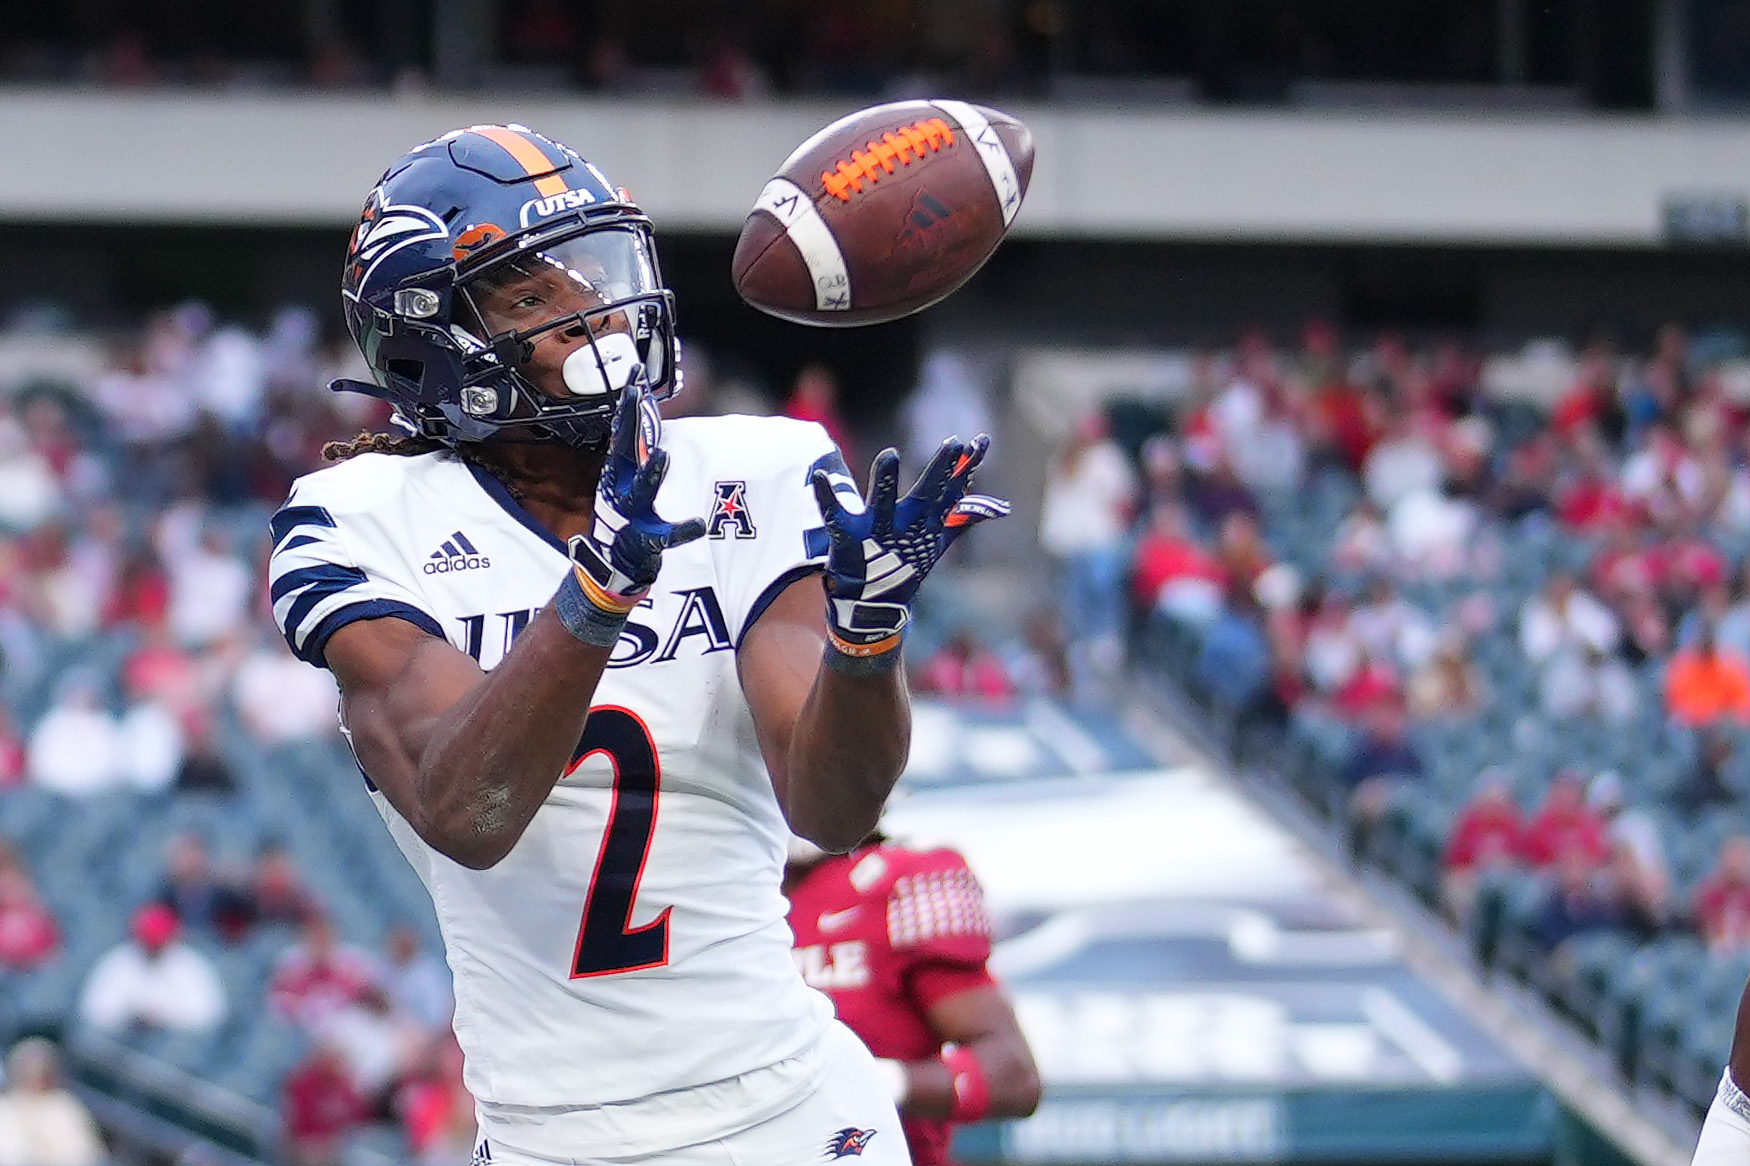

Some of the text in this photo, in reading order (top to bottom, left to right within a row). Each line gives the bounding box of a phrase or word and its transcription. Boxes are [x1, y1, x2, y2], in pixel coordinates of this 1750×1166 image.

[526, 187, 597, 220] UTSA
[423, 554, 491, 575] adidas
[455, 585, 736, 674] USA
[562, 703, 674, 980] 2
